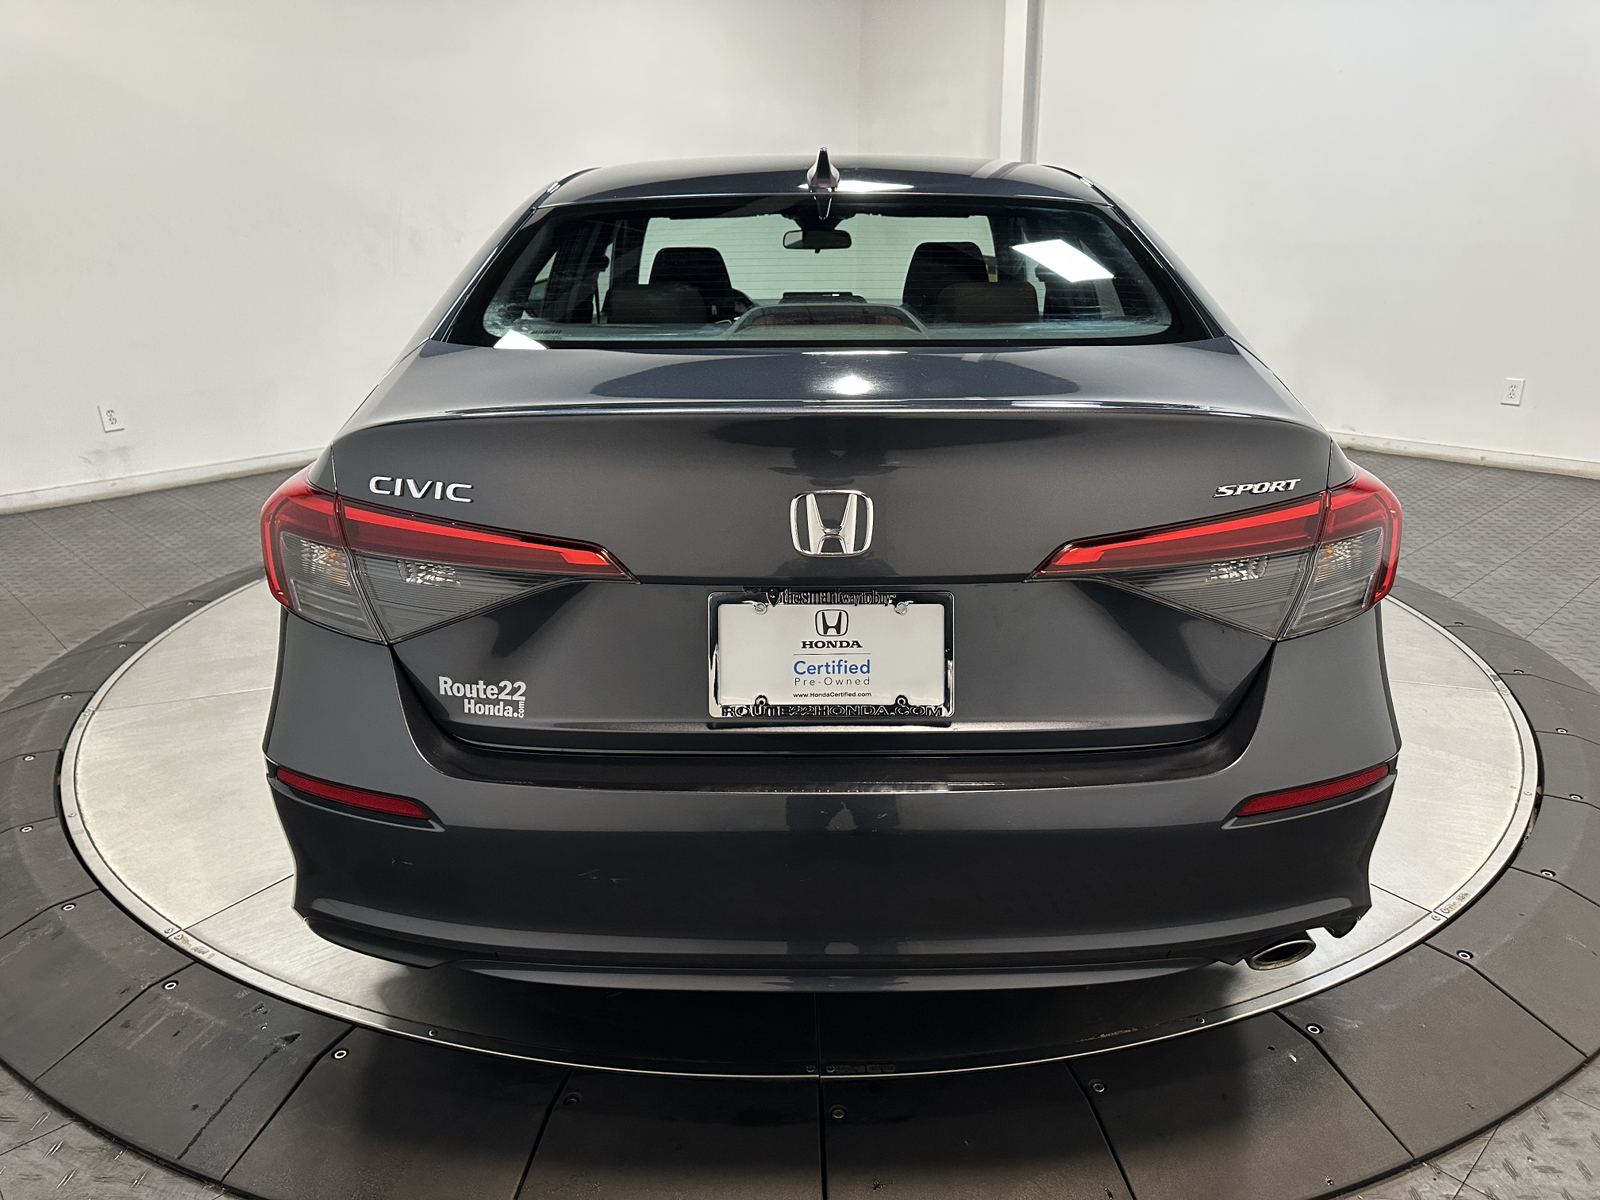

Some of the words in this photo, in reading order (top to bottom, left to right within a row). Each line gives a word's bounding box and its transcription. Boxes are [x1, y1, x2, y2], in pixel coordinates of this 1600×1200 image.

[368, 475, 474, 503] CIVIC
[1211, 478, 1302, 499] SPORT
[801, 640, 863, 649] HONDA
[793, 659, 871, 675] Certified
[438, 675, 527, 701] Route22
[794, 676, 870, 686] Pre-Owned
[721, 704, 943, 717] ROUTE22HONDA.COM
